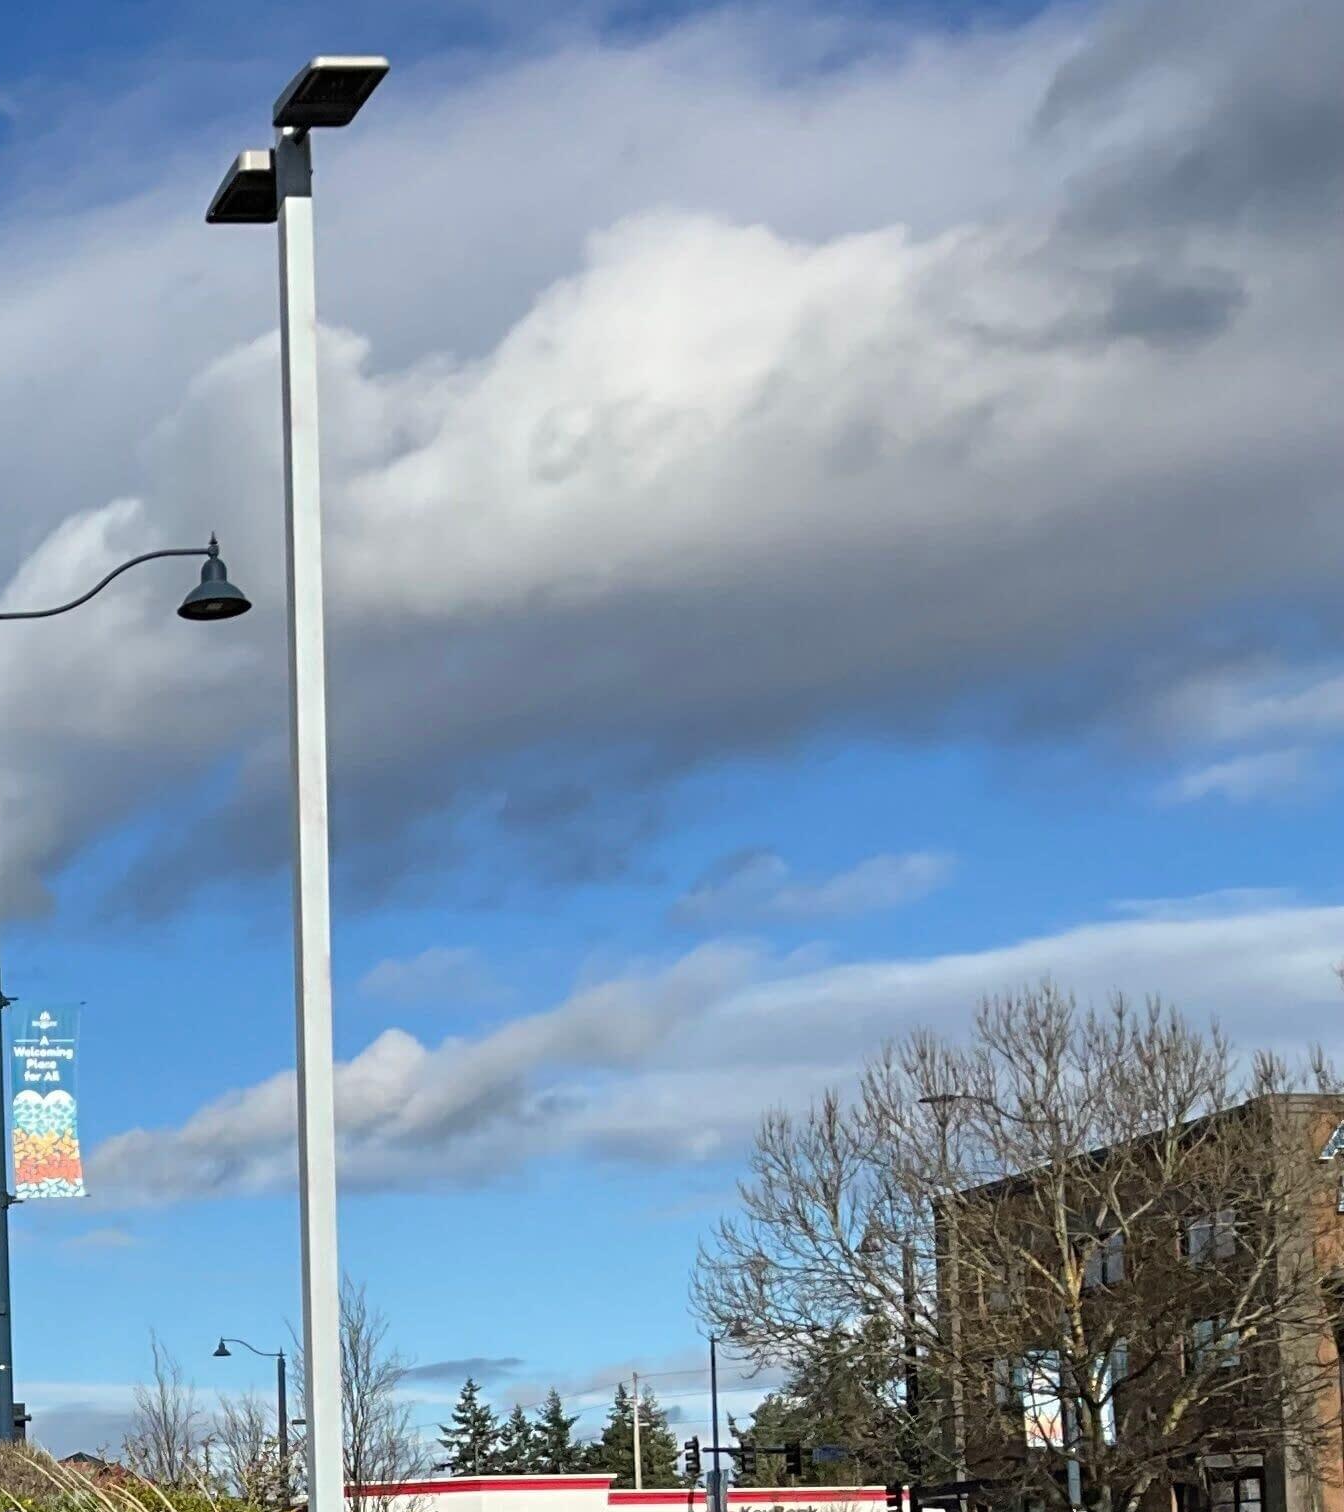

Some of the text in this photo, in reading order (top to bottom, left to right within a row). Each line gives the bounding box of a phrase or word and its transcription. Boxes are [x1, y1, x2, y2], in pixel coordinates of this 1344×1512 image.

[40, 1036, 49, 1046] A
[13, 1046, 74, 1059] Welcoming
[26, 1058, 57, 1069] Place
[24, 1070, 60, 1081] for All
